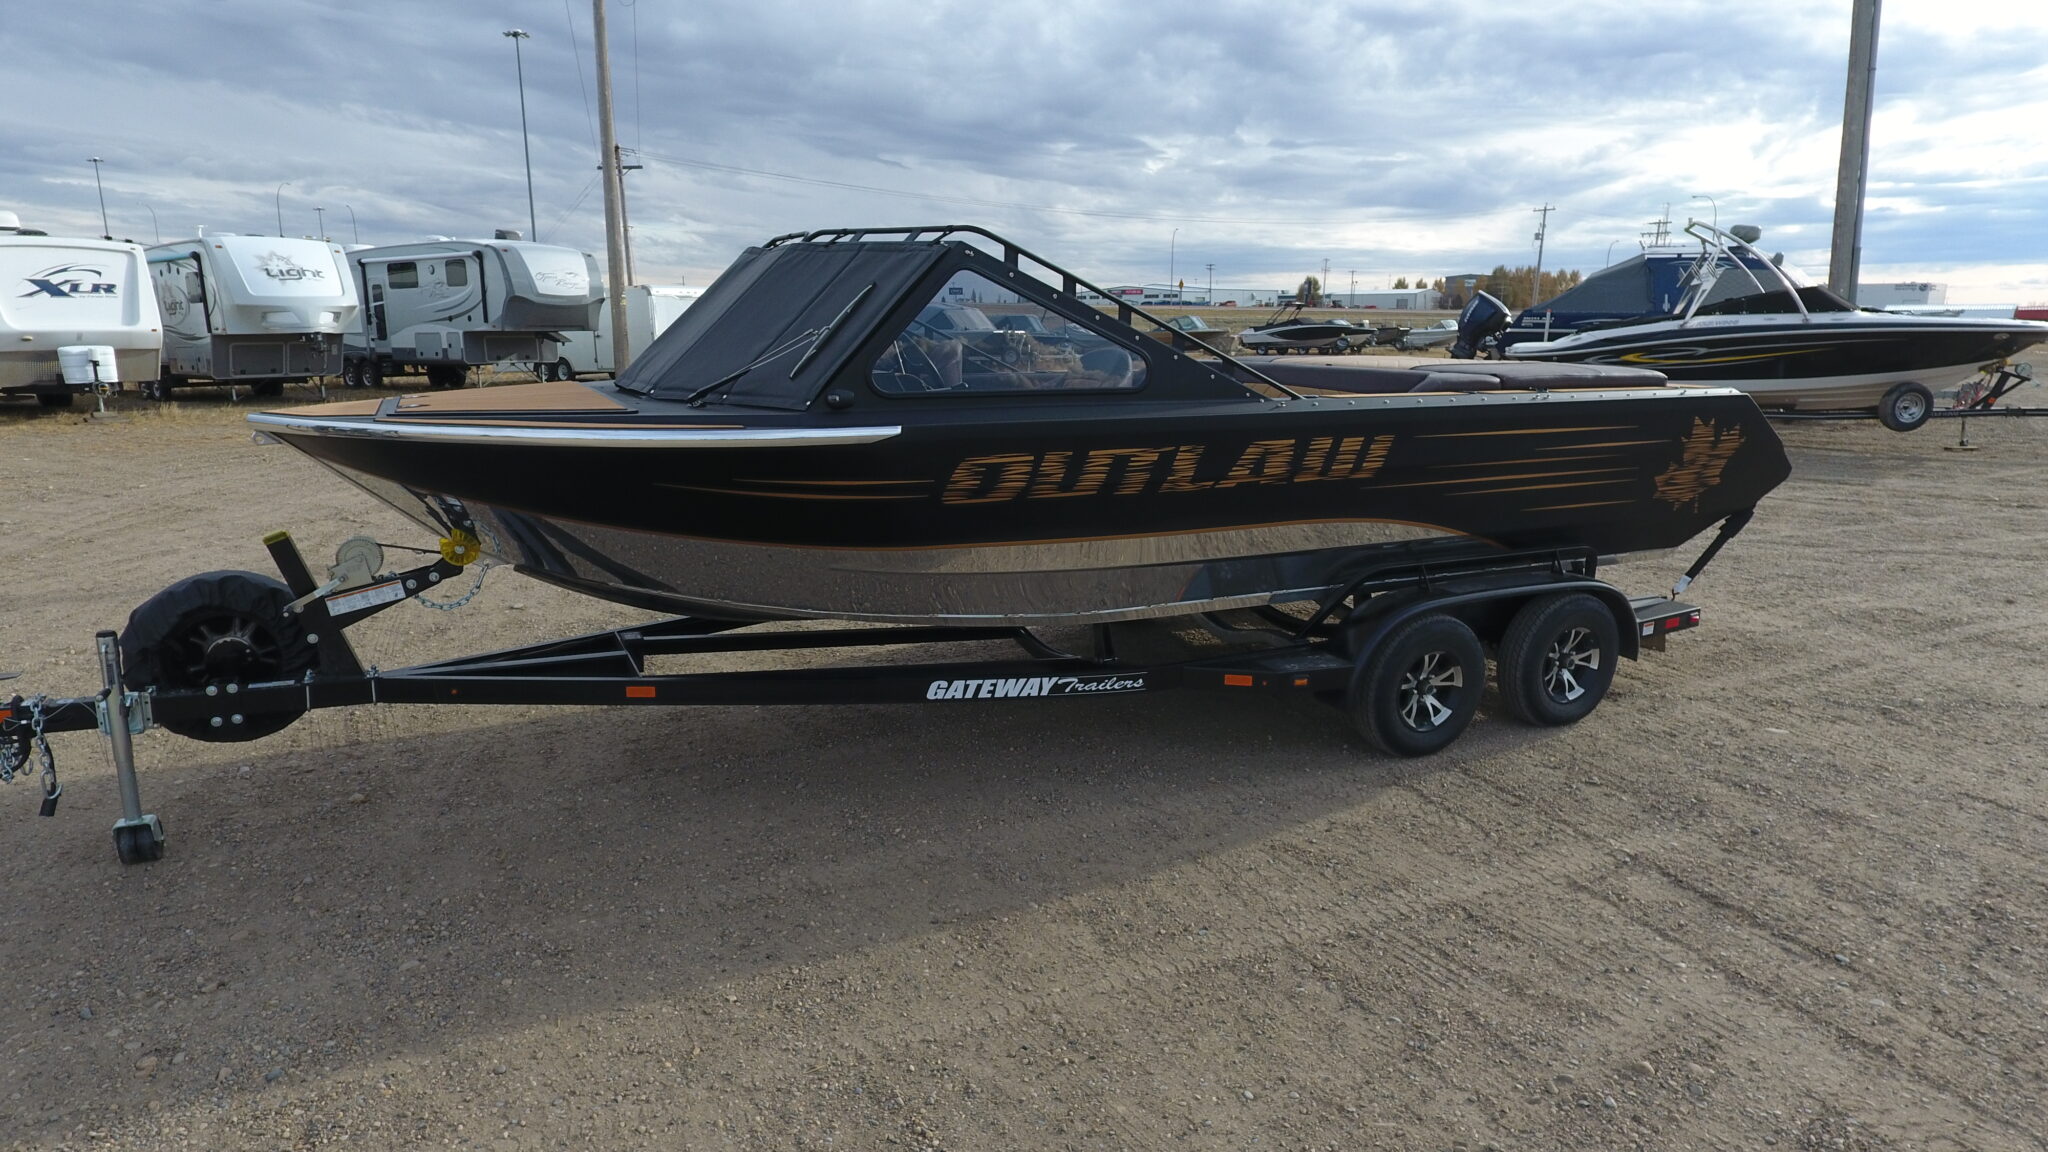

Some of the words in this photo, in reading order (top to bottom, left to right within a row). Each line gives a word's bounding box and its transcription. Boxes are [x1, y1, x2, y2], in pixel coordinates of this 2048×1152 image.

[16, 278, 117, 298] XLR
[942, 435, 1395, 504] OUTLAW
[926, 677, 1059, 700] GATEWAY
[1057, 677, 1145, 693] Trailers
